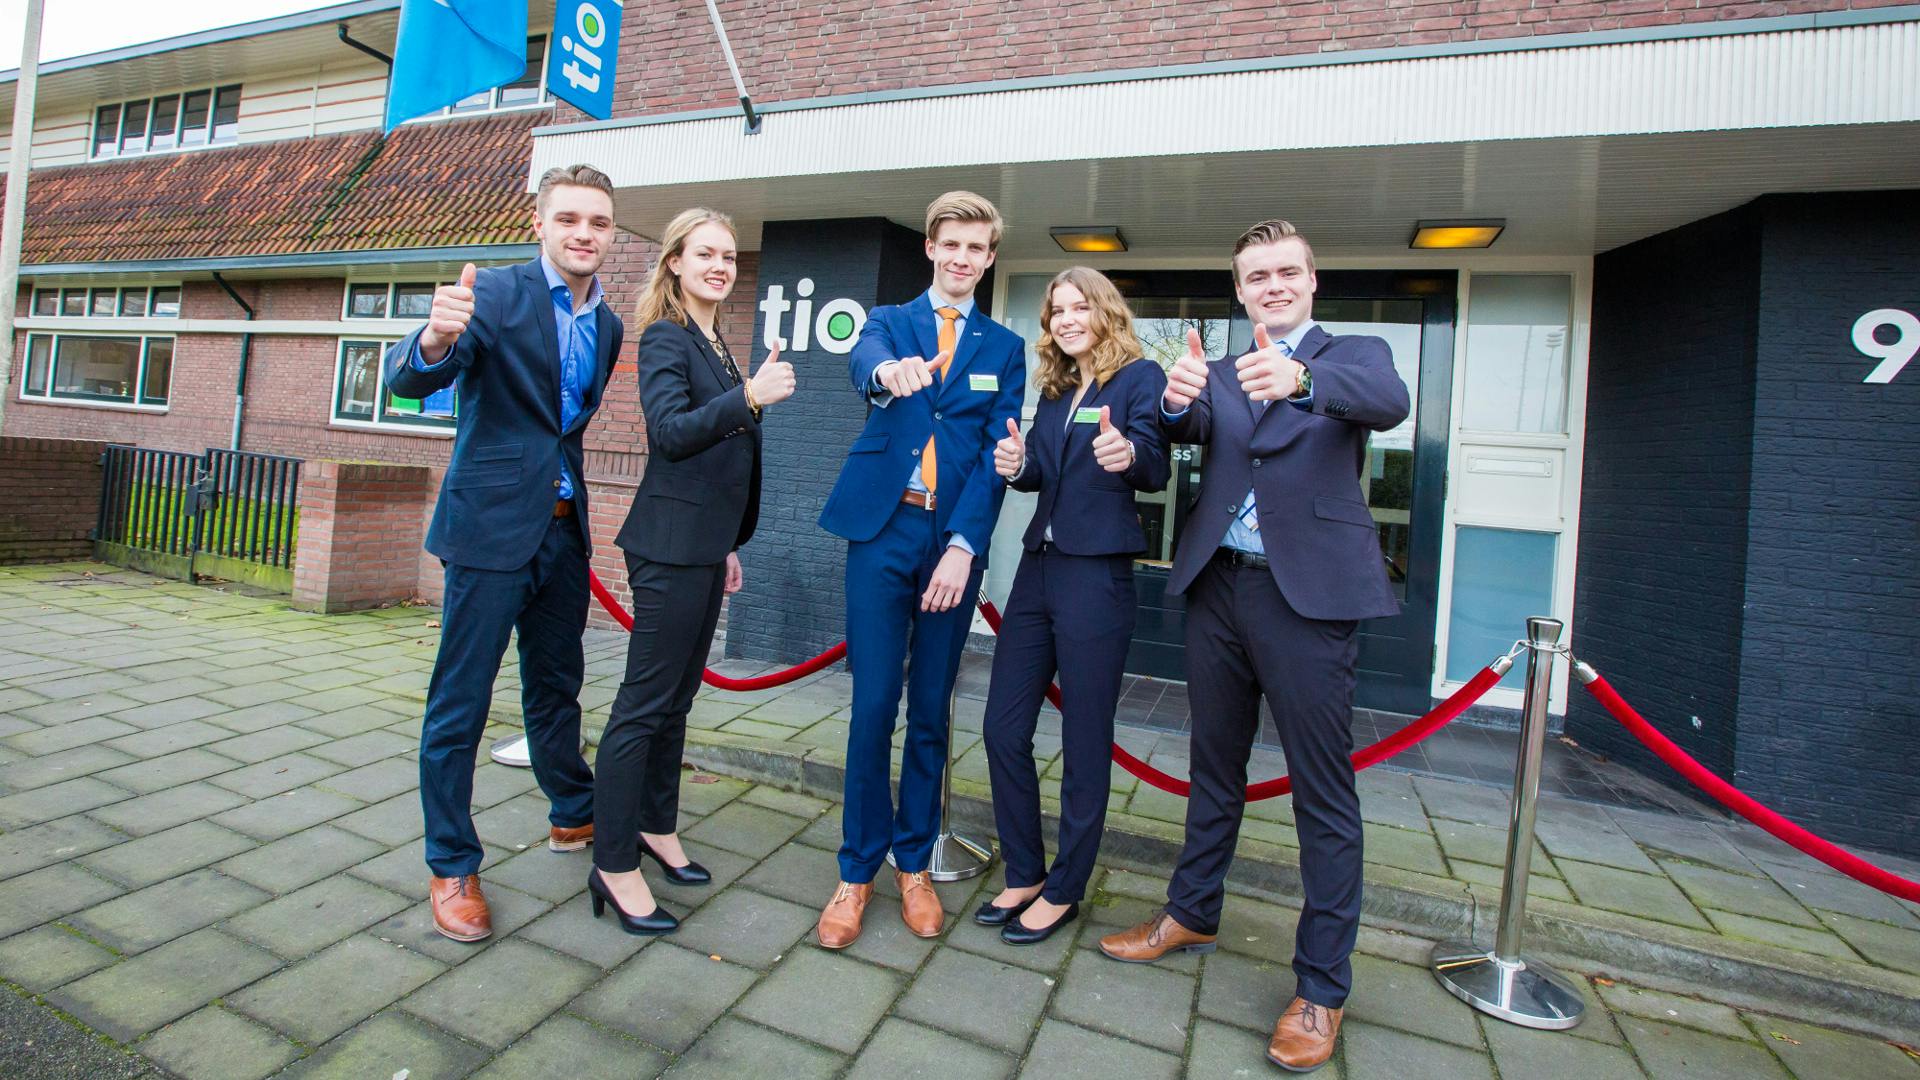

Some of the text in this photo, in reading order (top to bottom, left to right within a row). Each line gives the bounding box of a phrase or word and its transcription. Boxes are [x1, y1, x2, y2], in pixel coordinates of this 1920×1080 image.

[562, 2, 606, 93] tio
[759, 277, 868, 354] tio
[1850, 308, 1920, 384] 9
[1171, 448, 1191, 461] ss
